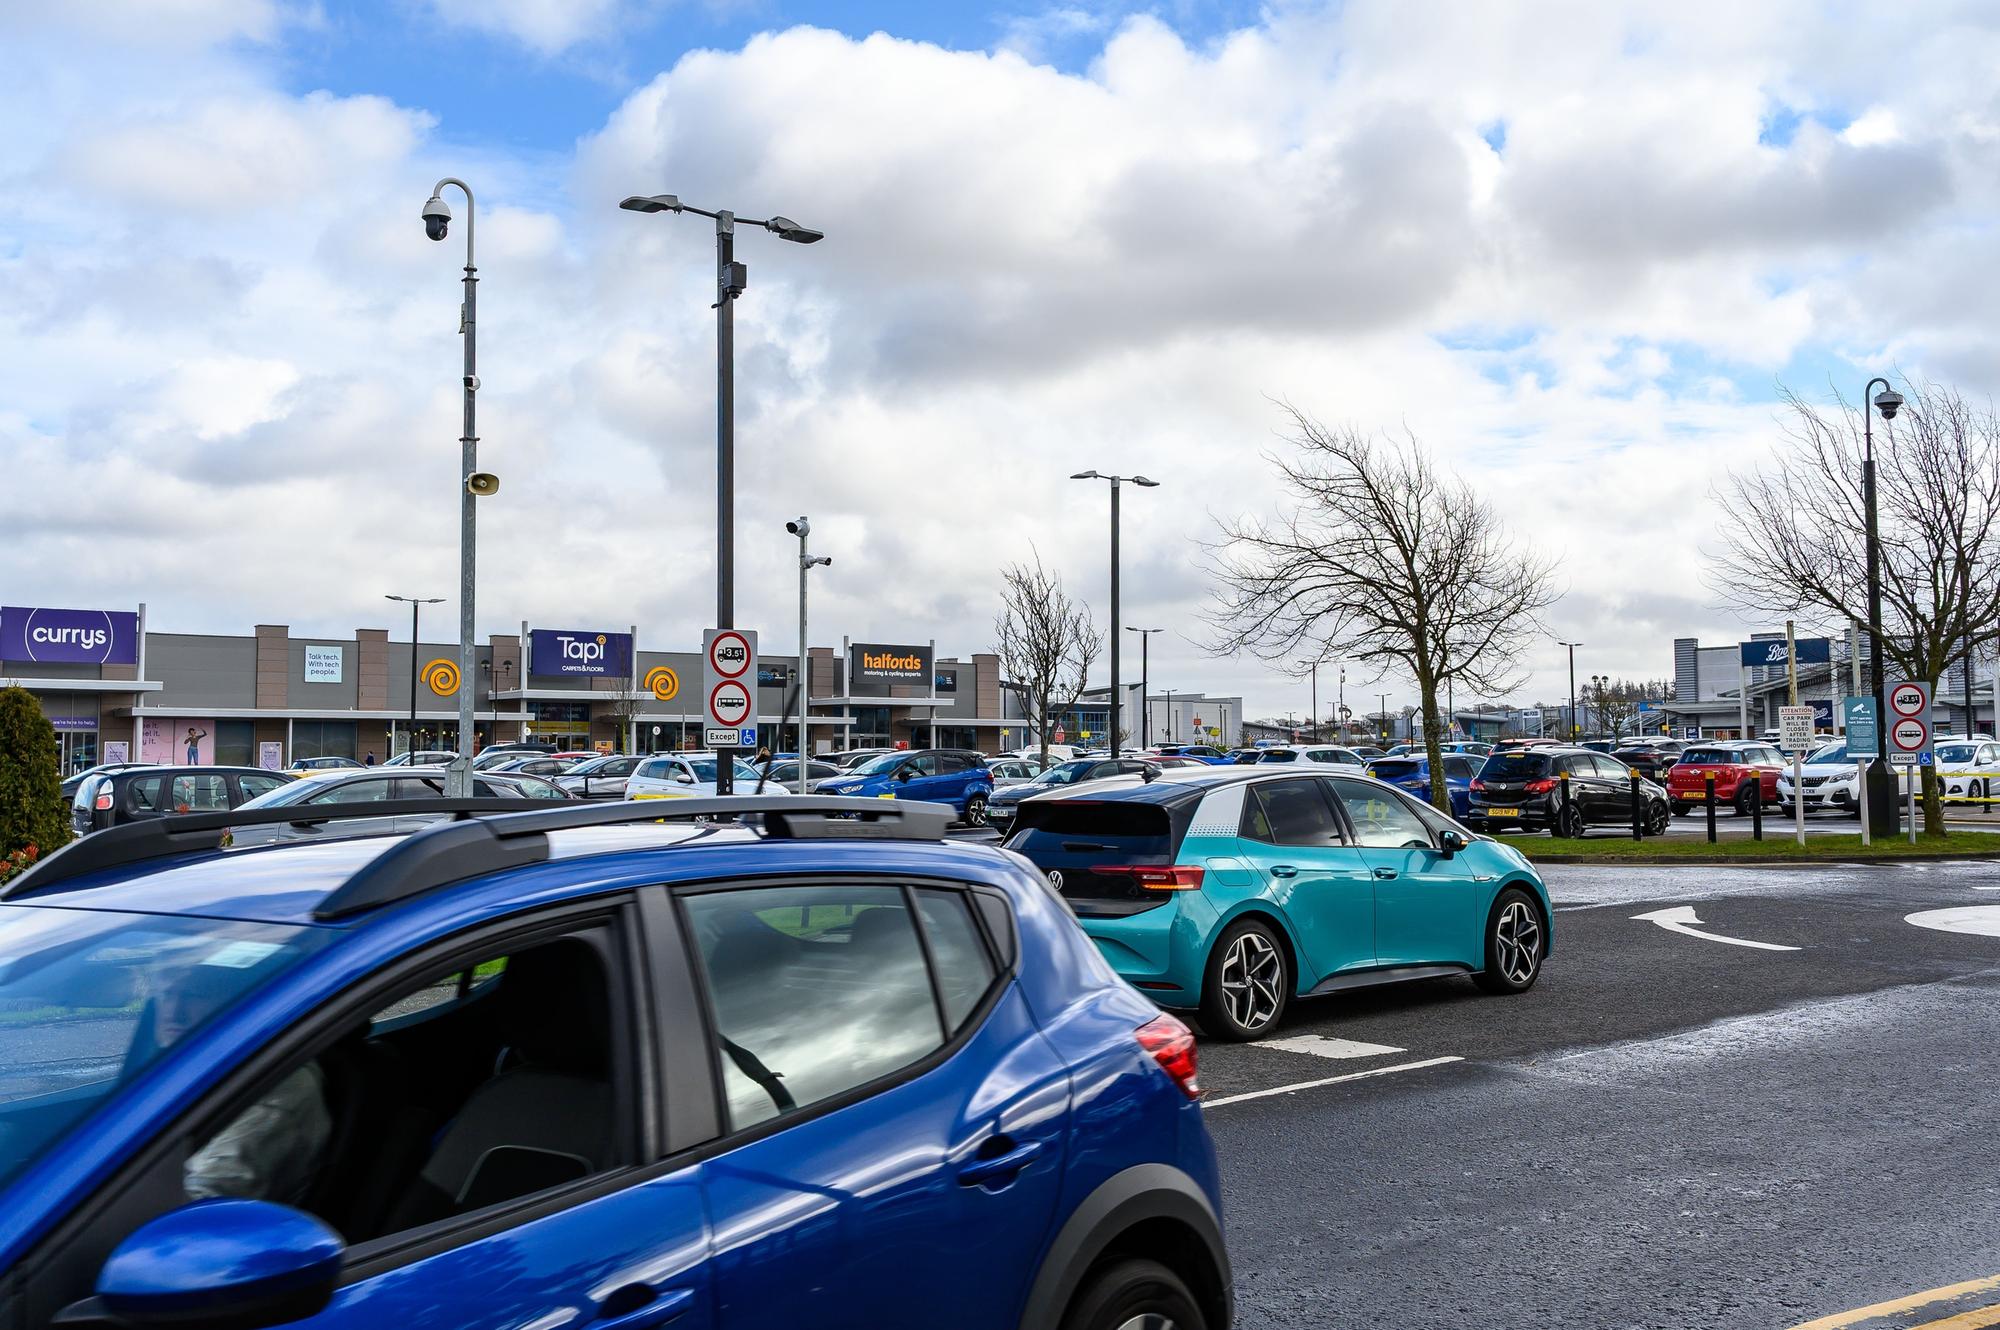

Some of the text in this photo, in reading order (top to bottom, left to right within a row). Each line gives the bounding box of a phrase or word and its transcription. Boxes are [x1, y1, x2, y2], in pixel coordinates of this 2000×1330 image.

[33, 627, 107, 650] currys
[557, 634, 607, 664] Tapi
[725, 648, 743, 657] 3.5t
[308, 660, 324, 668] With
[863, 653, 921, 670] halfords
[709, 732, 736, 743] Except
[1892, 755, 1915, 764] Except
